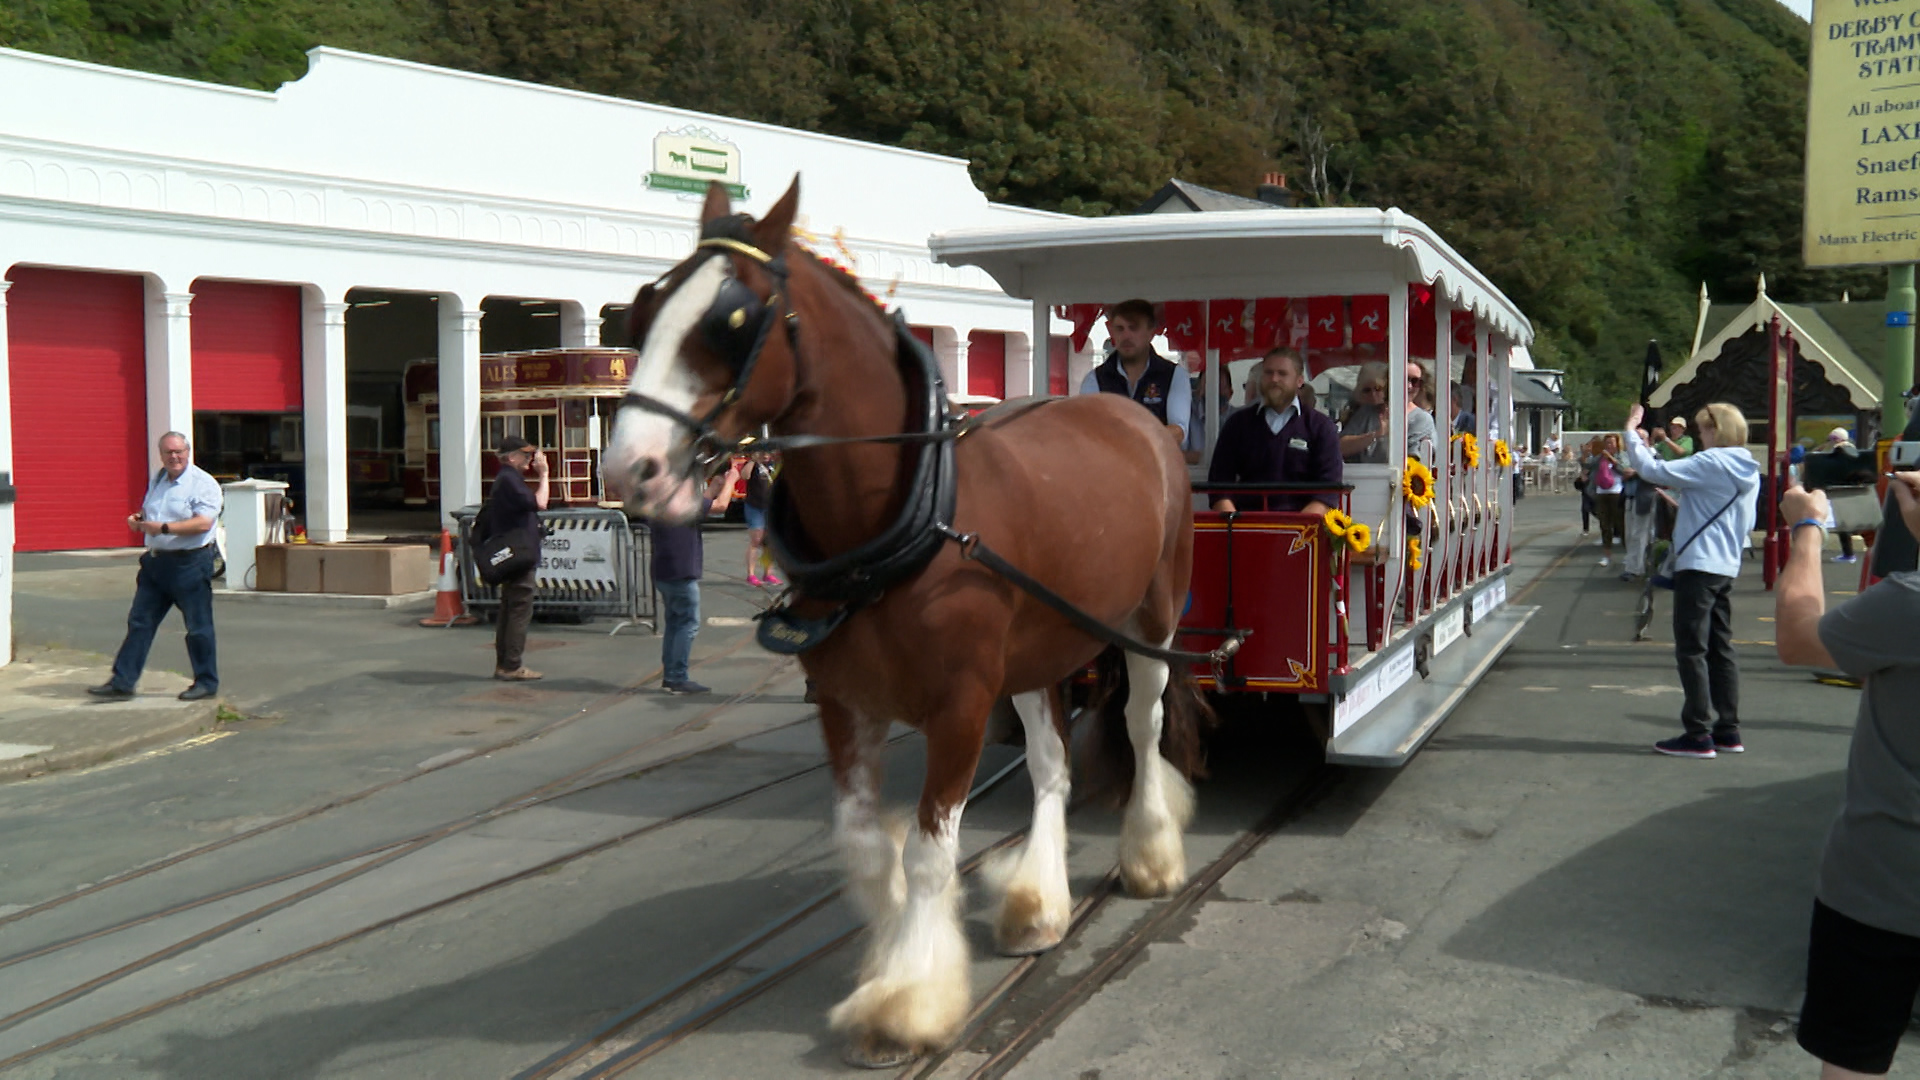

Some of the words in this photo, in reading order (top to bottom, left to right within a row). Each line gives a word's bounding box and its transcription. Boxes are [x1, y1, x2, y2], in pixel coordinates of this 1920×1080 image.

[1829, 13, 1905, 40] DERBY
[1850, 32, 1920, 58] TRAM
[1858, 54, 1920, 79] STAT
[1848, 101, 1870, 117] All
[1856, 150, 1920, 176] Snaef
[1856, 186, 1920, 205] Rams
[1818, 233, 1858, 246] Manx
[1862, 229, 1918, 244] Electric
[485, 364, 517, 382] ALES
[551, 557, 577, 570] ONLY
